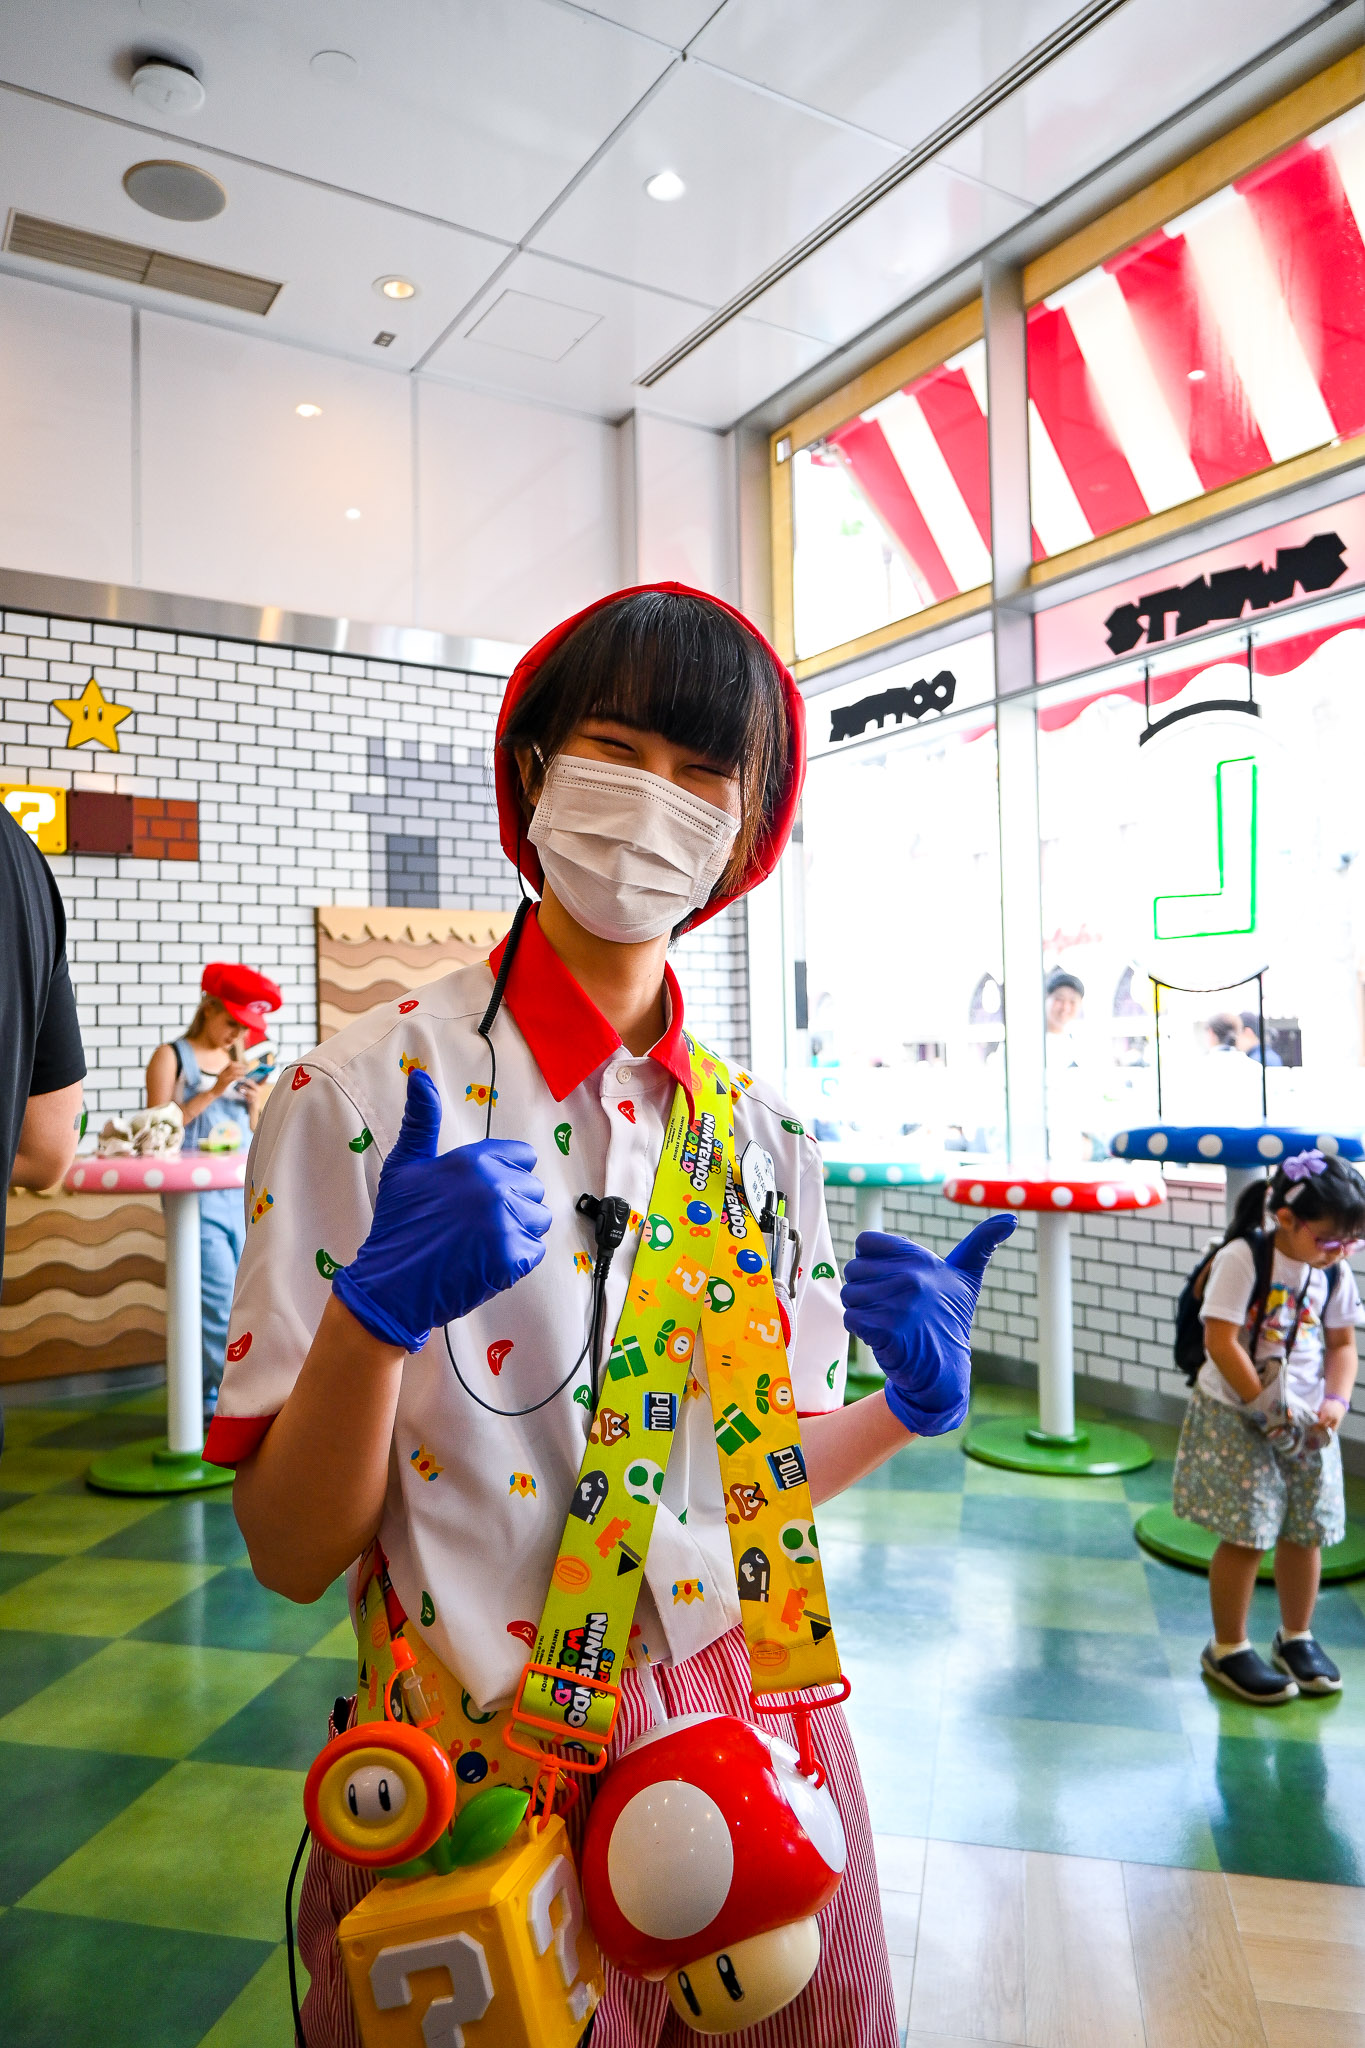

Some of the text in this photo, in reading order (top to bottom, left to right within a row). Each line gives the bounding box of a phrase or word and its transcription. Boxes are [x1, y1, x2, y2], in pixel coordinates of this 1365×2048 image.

[681, 1120, 702, 1173] WORLD
[690, 1112, 715, 1191] NINTENDO
[709, 1138, 724, 1175] SUPER
[650, 1393, 671, 1431] POW
[773, 1447, 806, 1489] POW
[546, 1628, 560, 1666] UNIVERSAL
[564, 1612, 608, 1728] NINTENDO
[592, 1648, 615, 1698] SUPR
